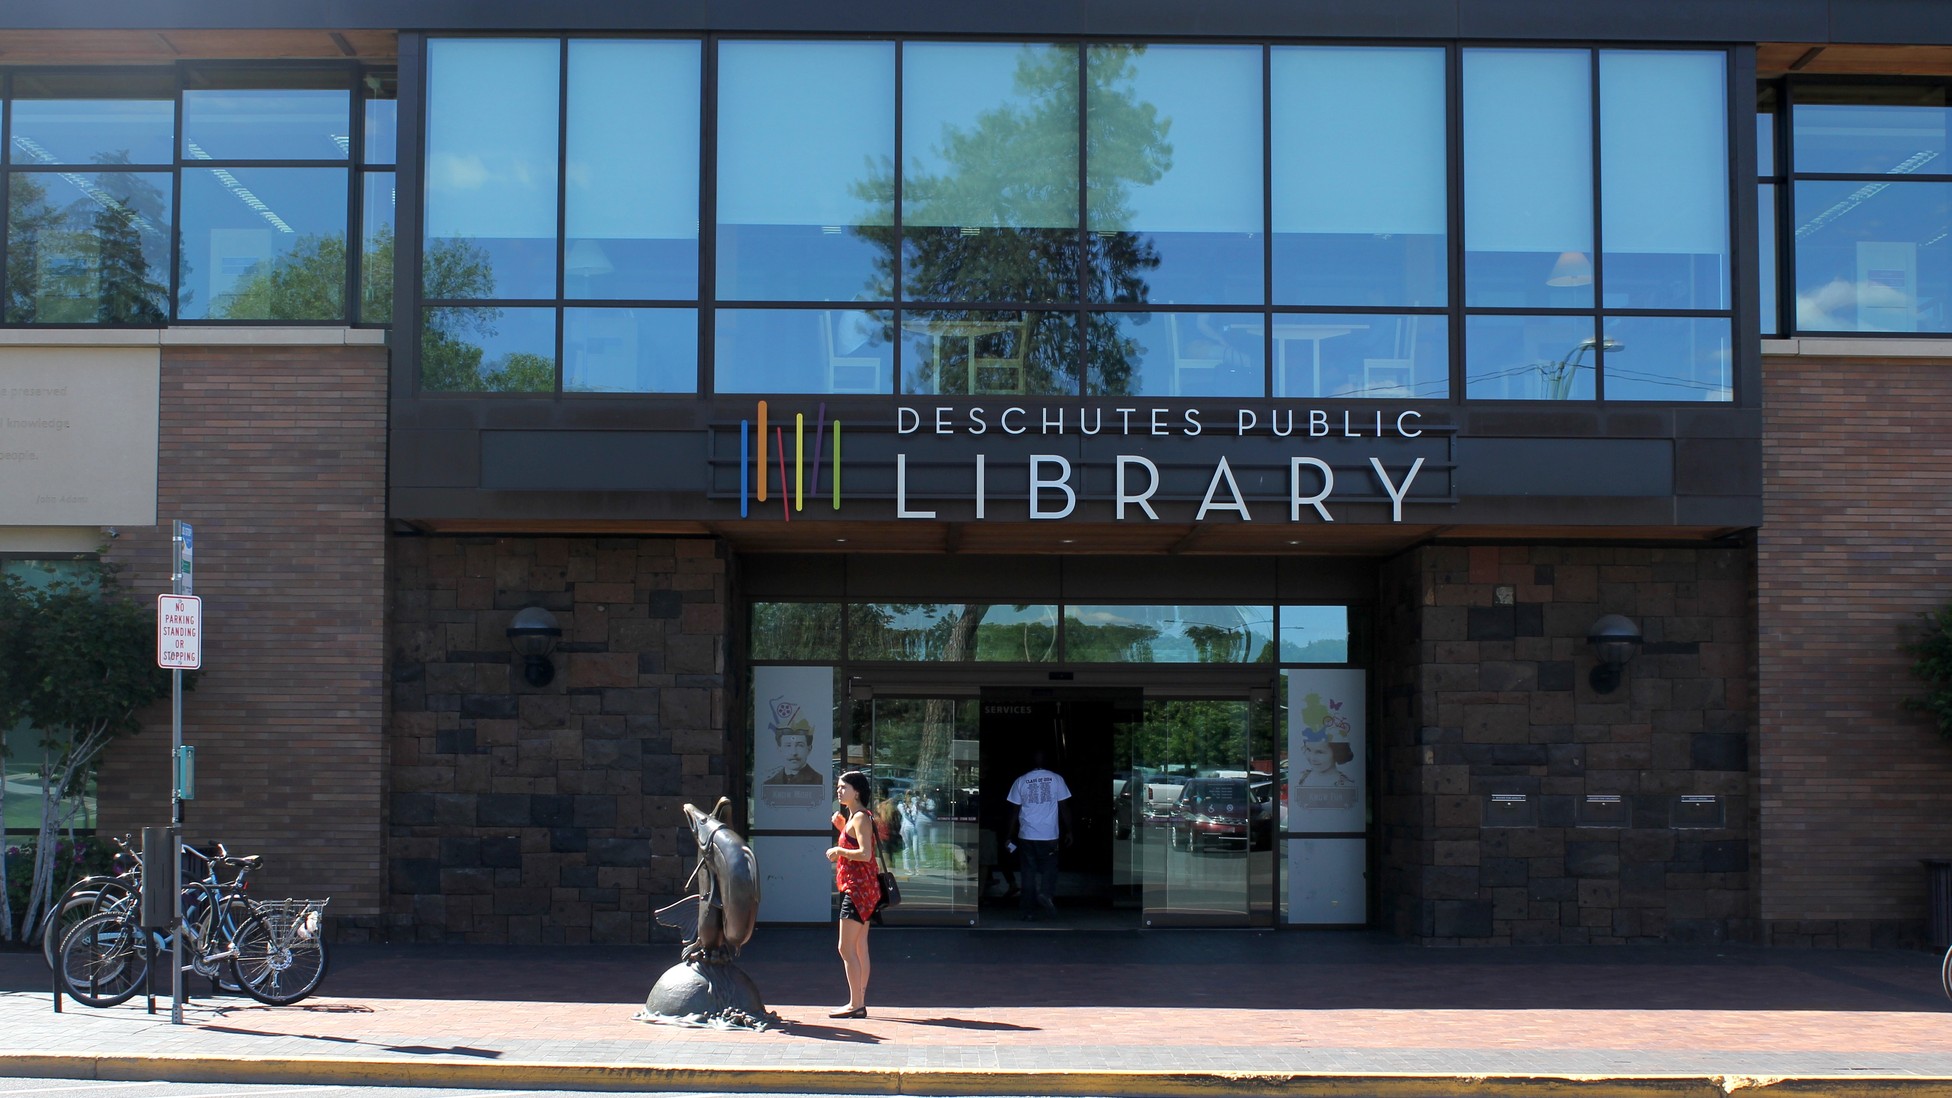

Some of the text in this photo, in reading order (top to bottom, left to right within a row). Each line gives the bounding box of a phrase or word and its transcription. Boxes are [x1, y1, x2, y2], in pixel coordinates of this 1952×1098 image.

[10, 386, 68, 400] preserved
[898, 407, 1422, 438] DESCHUTES PUBLIC
[897, 453, 1425, 522] LIBRARY
[175, 602, 185, 612] NO
[165, 614, 195, 625] PARKING
[163, 626, 197, 637] STANDING
[175, 639, 185, 649] OR
[163, 651, 196, 662] STOPPING
[984, 705, 1032, 714] SERVICES
